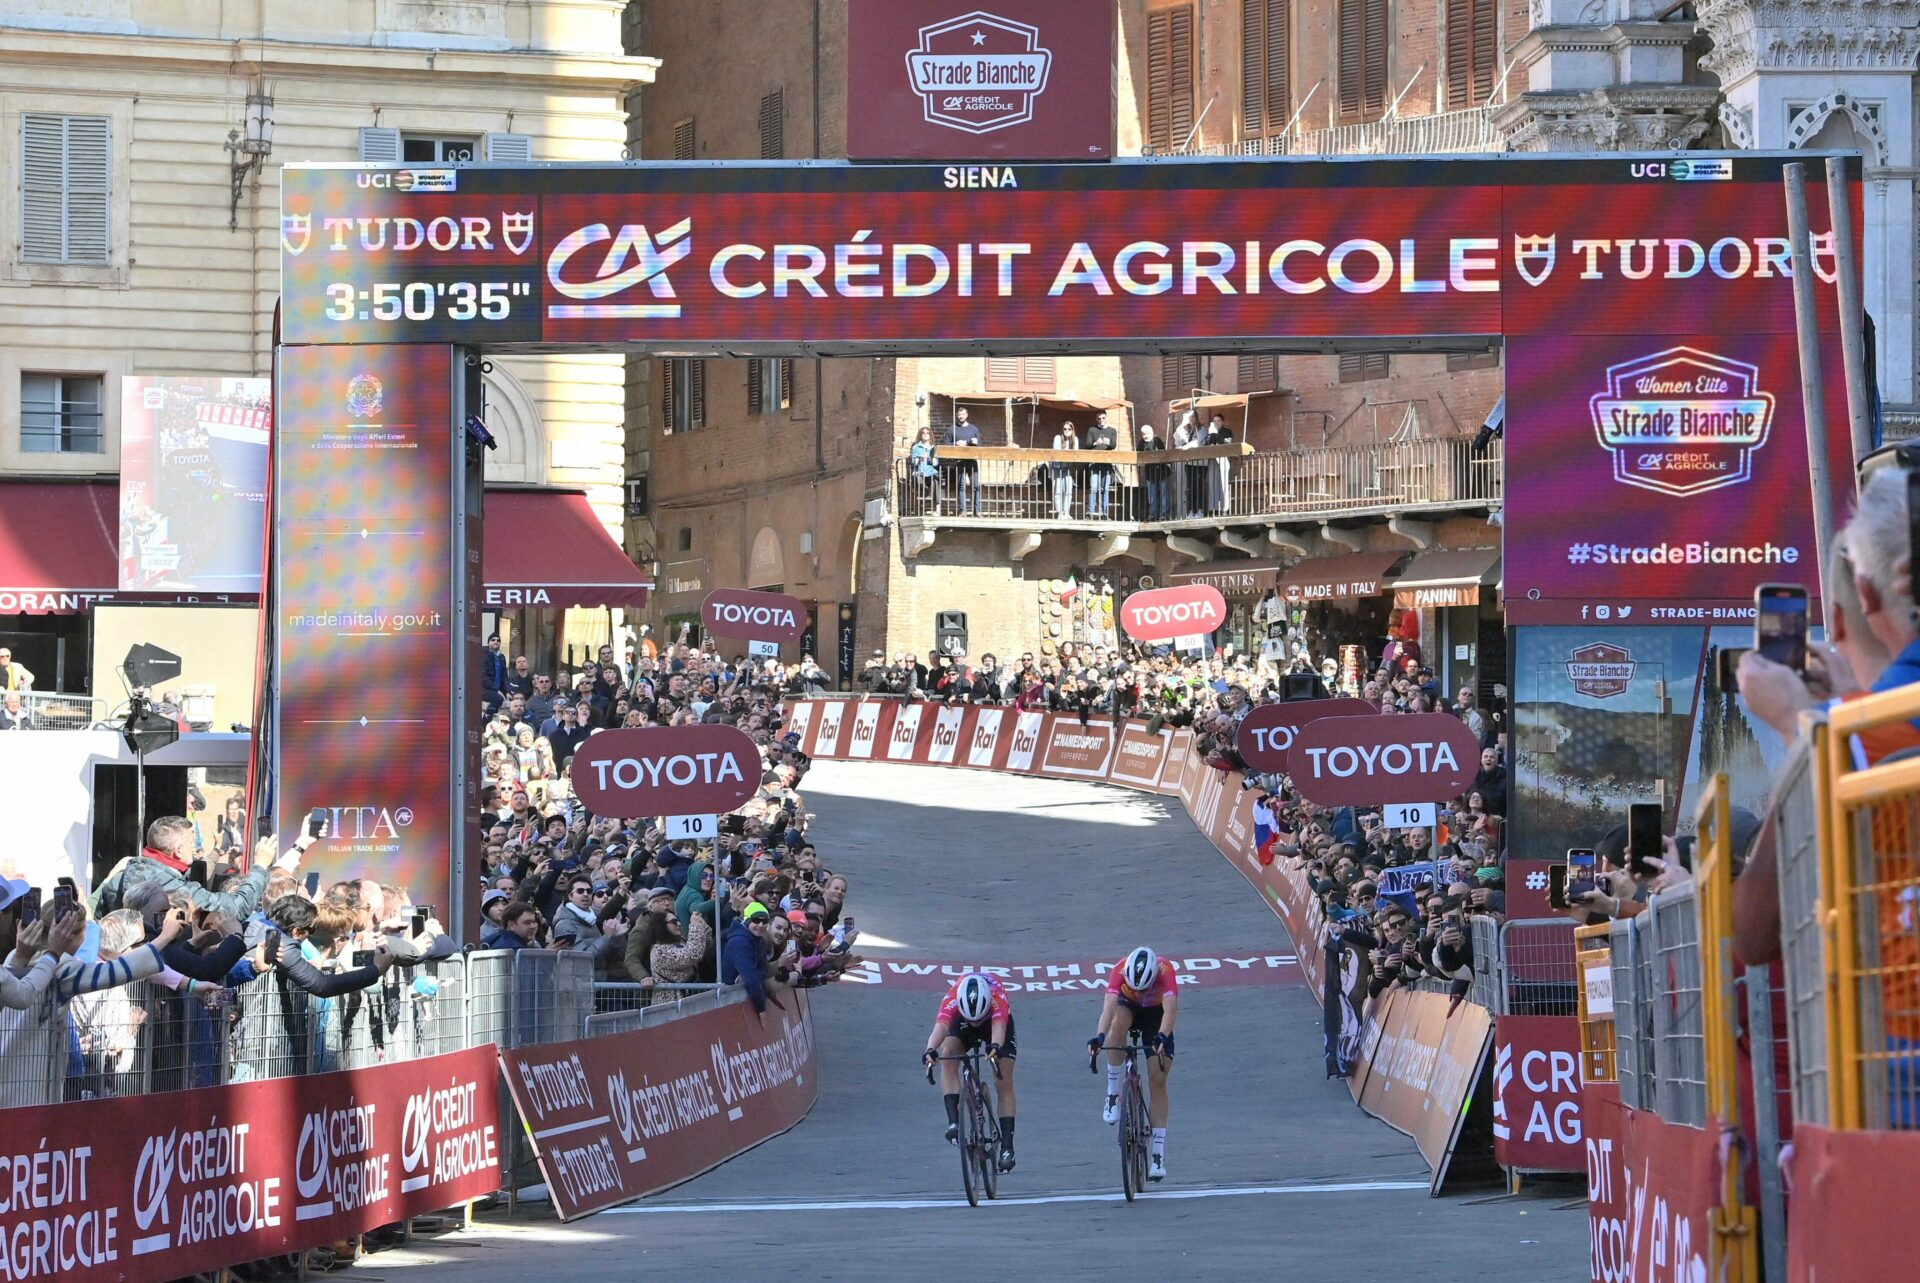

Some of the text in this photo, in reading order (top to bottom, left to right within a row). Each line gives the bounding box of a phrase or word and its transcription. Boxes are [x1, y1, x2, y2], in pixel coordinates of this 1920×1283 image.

[922, 61, 1036, 85] Strade Bianche
[965, 95, 1000, 103] CRÉDIT
[356, 173, 391, 188] UCI
[943, 166, 1018, 189] SIENA
[1630, 163, 1666, 178] UCI
[323, 216, 494, 251] TUDOR
[709, 229, 1501, 299] CRÉDIT AGRICOLE
[1572, 236, 1796, 280] TUDOR
[1635, 375, 1729, 395] Women Elite
[1610, 407, 1755, 438] Strade Bianche
[1665, 450, 1710, 462] CRÉDIT
[1665, 461, 1728, 470] AGRICOLE
[1567, 541, 1799, 564] #StradeBianche
[1191, 573, 1255, 588] SOUVENIRS
[1304, 584, 1331, 598] MADE
[1336, 583, 1347, 596] IN
[1350, 581, 1376, 595] ITALY
[1416, 587, 1457, 604] PANINI
[289, 610, 441, 630] madeinitaly.gov.it
[712, 603, 796, 628] TOYOTA
[1131, 600, 1216, 626] TOYOTA
[761, 644, 773, 655] 50
[1572, 664, 1630, 677] Strade Bianche
[820, 716, 840, 740] Rai
[854, 718, 876, 742] Rai
[894, 719, 916, 744] Rai
[934, 722, 958, 747] Rai
[974, 725, 997, 749] Rai
[1014, 728, 1037, 754] Rai
[591, 751, 743, 791] TOYOTA
[1306, 742, 1460, 778] TOYOTA
[327, 806, 400, 839] ITA
[682, 818, 702, 834] 10
[1400, 808, 1420, 823] 10
[328, 844, 400, 852] ITALIAN TRADE AGENCY
[729, 1042, 764, 1100] CRÉDIT
[762, 1038, 793, 1090] AGRICOLE
[1521, 1050, 1583, 1094] CR
[532, 1060, 586, 1112] TUDOR
[431, 1076, 477, 1134] CRÉDIT
[632, 1069, 719, 1140] CRÉDIT AGRICOLE
[329, 1097, 376, 1157] CRÉDIT
[178, 1115, 249, 1185] CRÉDIT
[433, 1124, 498, 1186] AGRICOLE
[333, 1153, 390, 1211] AGRICOLE
[564, 1143, 614, 1197] TUDOR
[177, 1177, 281, 1247] AGRICOLE
